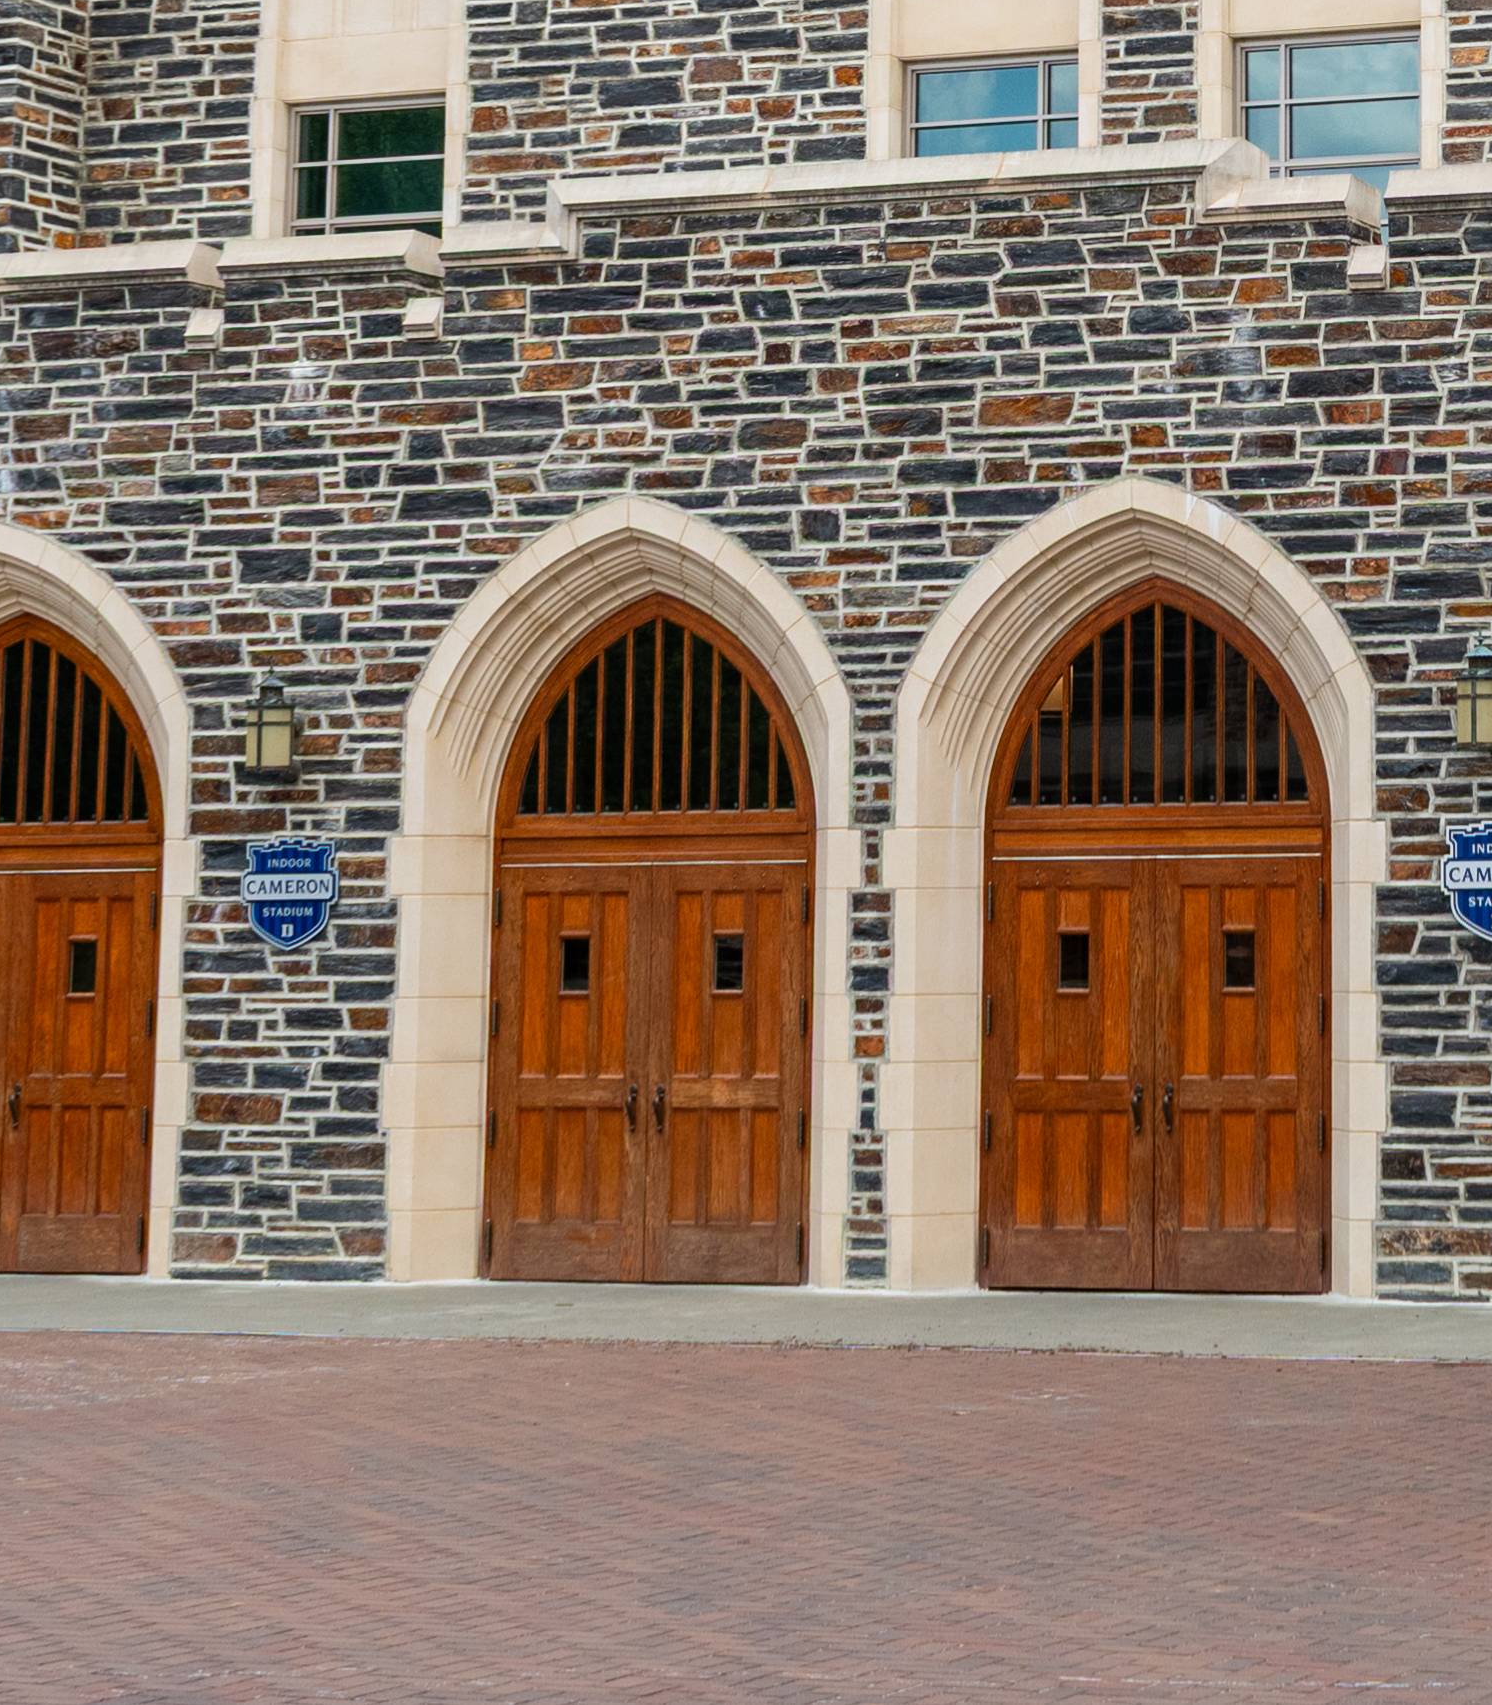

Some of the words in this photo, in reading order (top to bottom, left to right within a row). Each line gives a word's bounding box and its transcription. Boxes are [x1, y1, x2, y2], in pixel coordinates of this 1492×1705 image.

[267, 857, 312, 869] INDOOR
[246, 878, 330, 895] CAMERON
[262, 906, 314, 918] STADIUM
